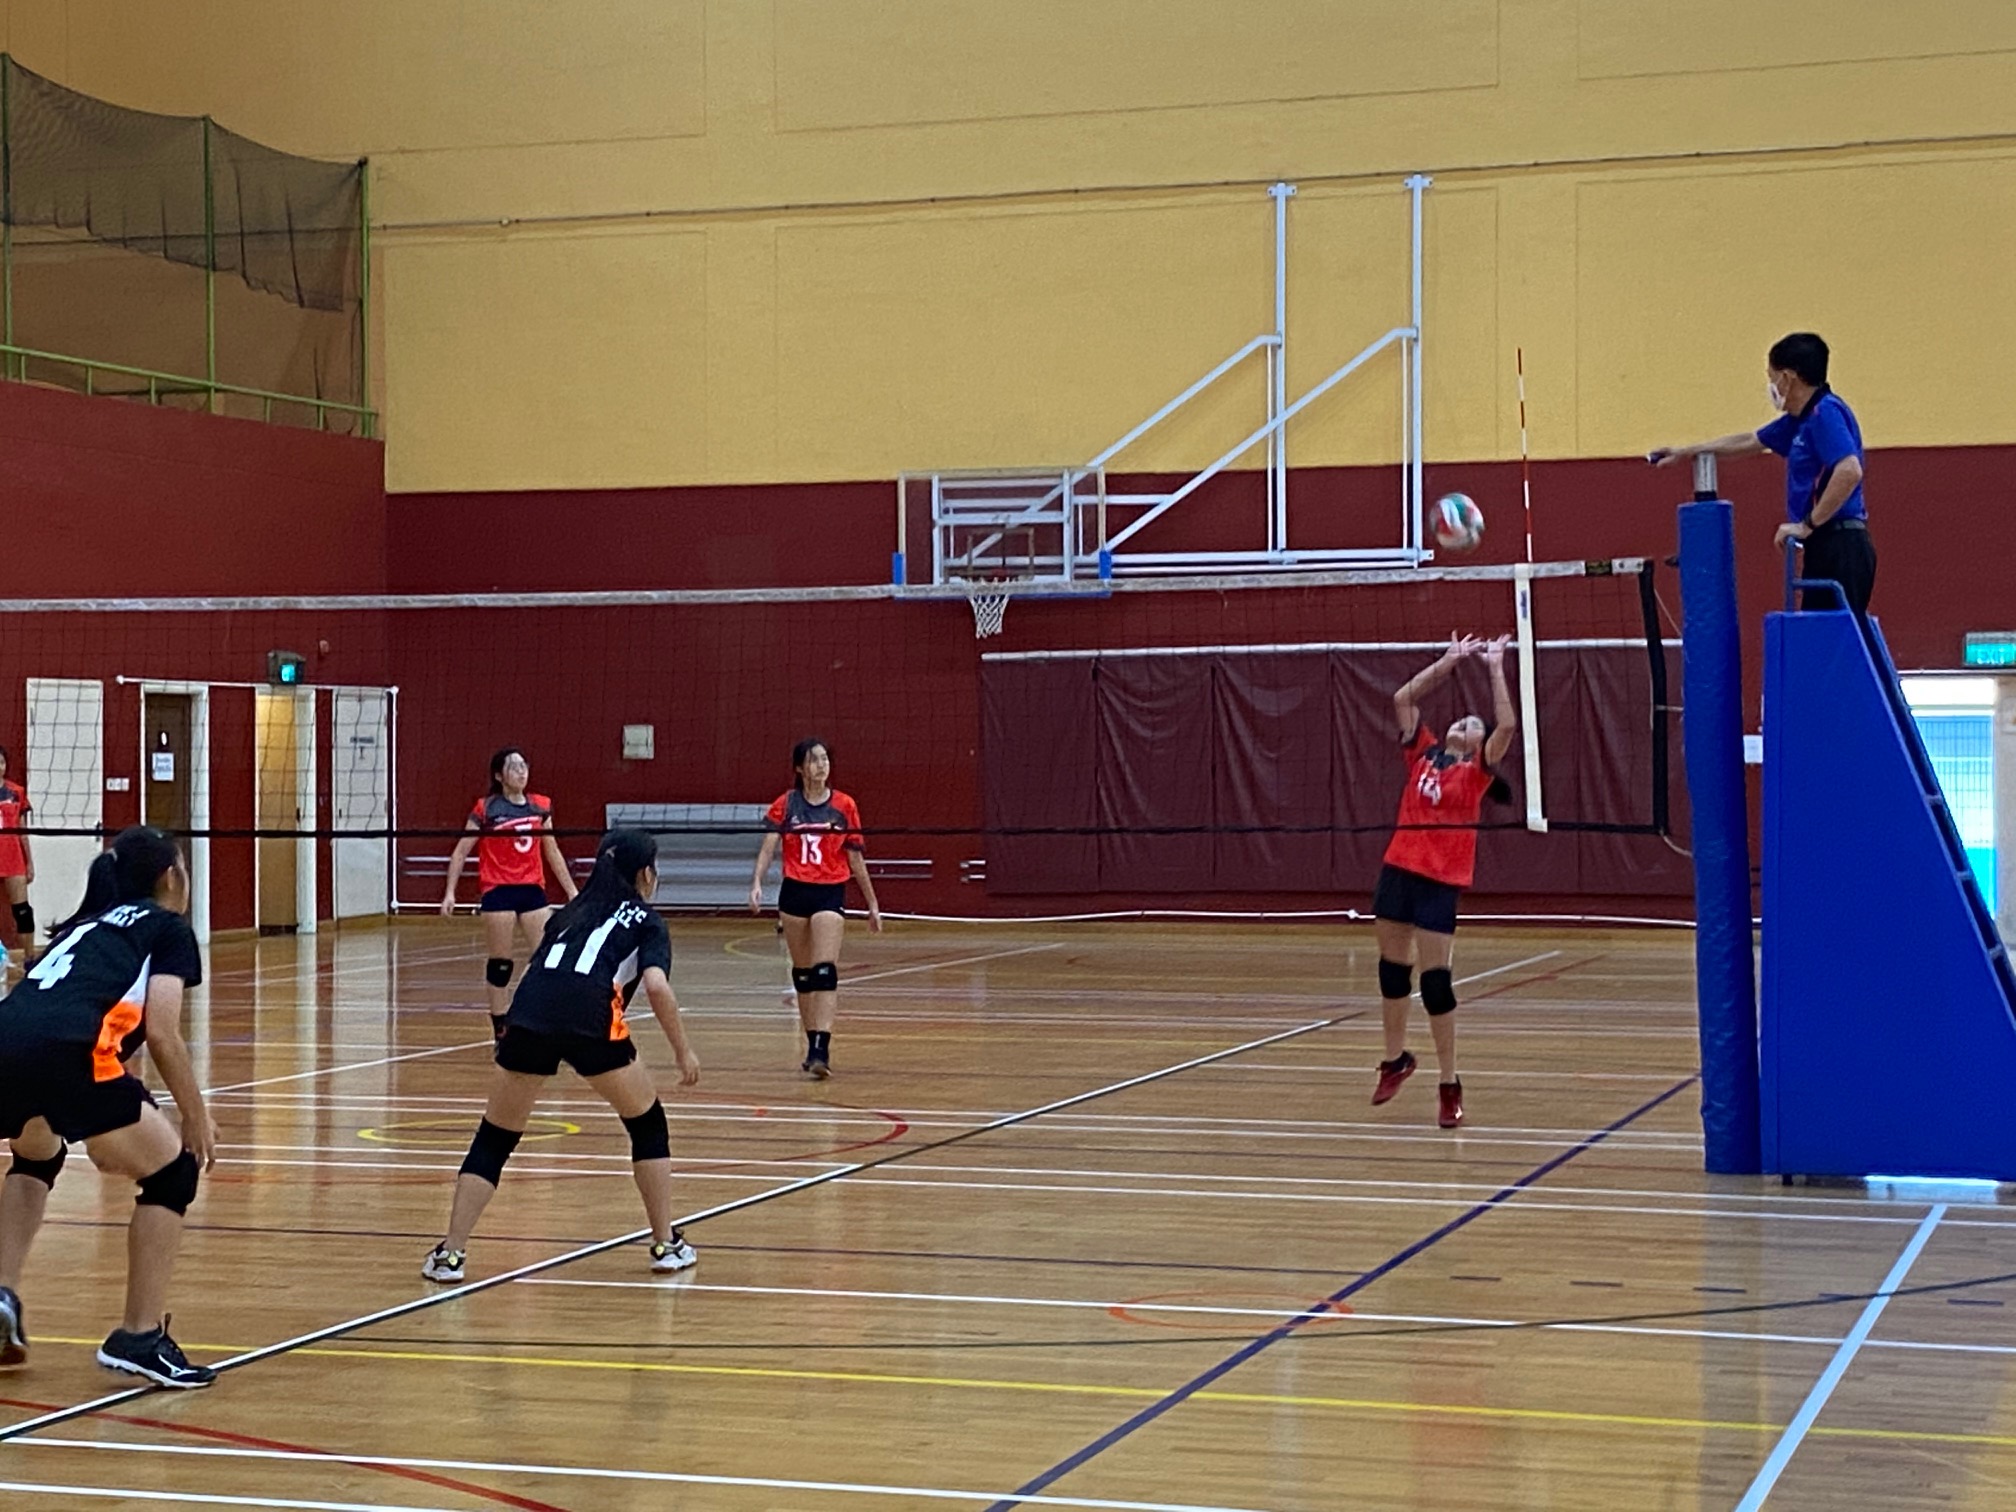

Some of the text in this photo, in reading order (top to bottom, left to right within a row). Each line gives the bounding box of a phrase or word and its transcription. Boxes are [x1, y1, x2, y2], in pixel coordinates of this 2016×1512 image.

[1976, 647, 2006, 665] EXIT
[800, 833, 823, 865] 13
[27, 921, 98, 990] 4
